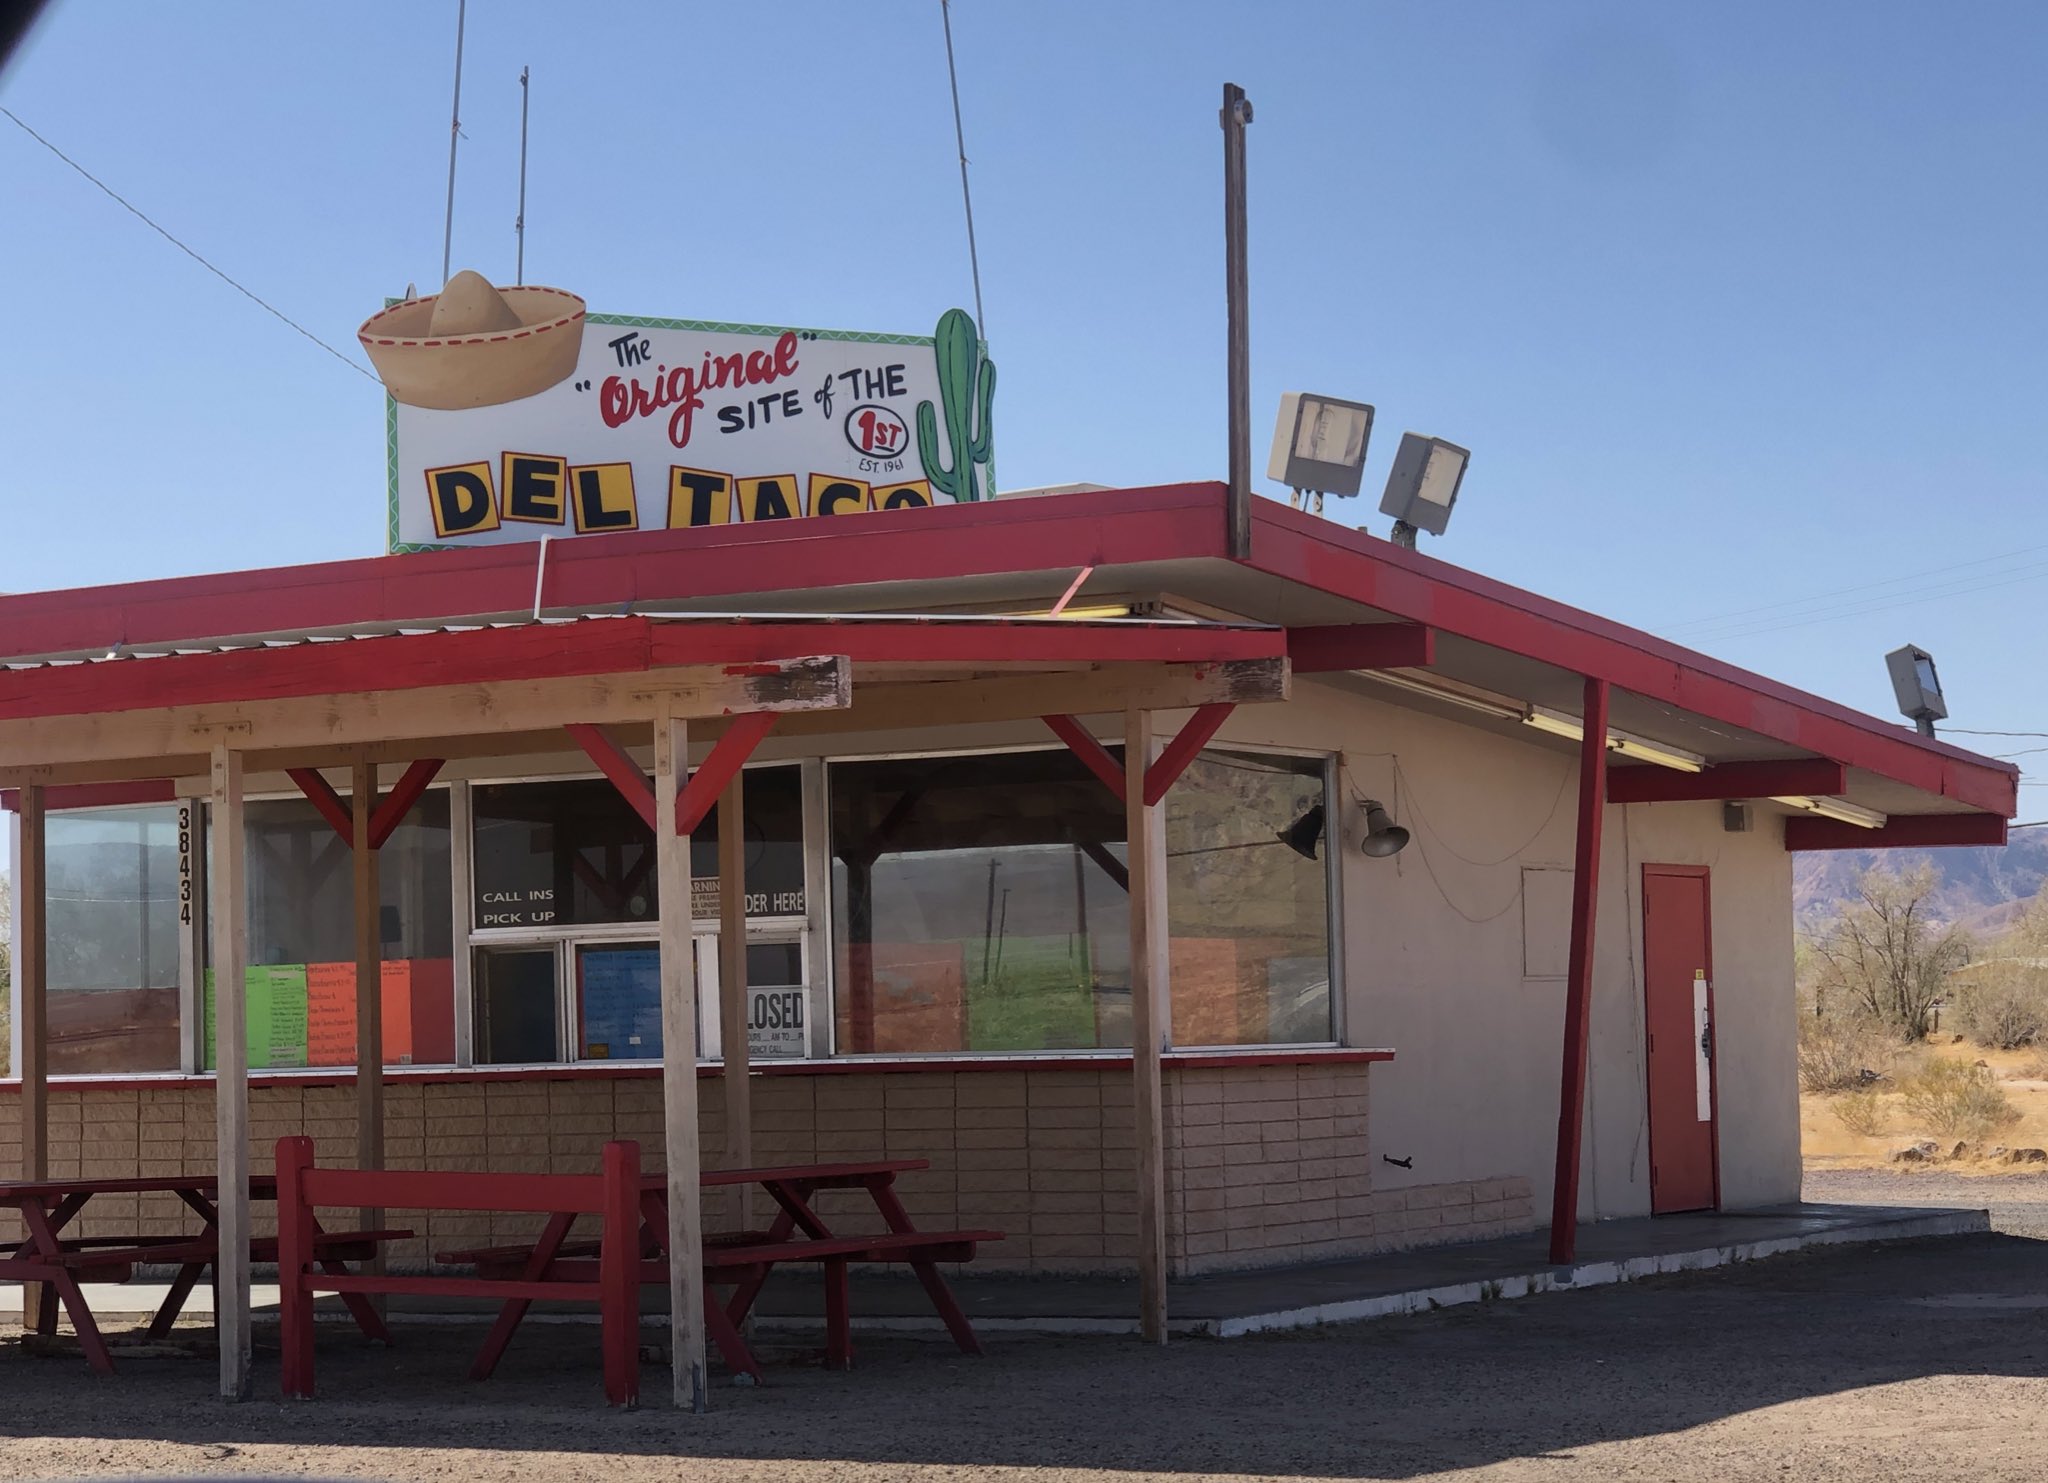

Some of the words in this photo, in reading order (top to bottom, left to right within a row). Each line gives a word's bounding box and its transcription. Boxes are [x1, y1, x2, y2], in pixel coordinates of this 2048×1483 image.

[608, 331, 652, 368] The
[717, 389, 803, 434] SITE
[814, 373, 835, 420] of
[838, 363, 907, 400] THE
[858, 410, 902, 452] 1ST
[858, 458, 880, 474] EST.
[883, 458, 904, 473] 1961
[435, 457, 632, 532] DEL
[179, 807, 191, 926] 38434
[482, 891, 522, 903] CALL
[529, 889, 555, 901] INS
[691, 881, 720, 893] RNIN
[744, 893, 768, 913] DER
[773, 891, 804, 912] HERE
[483, 912, 522, 925] PICK
[531, 911, 556, 922] UP
[747, 992, 804, 1030] OSED
